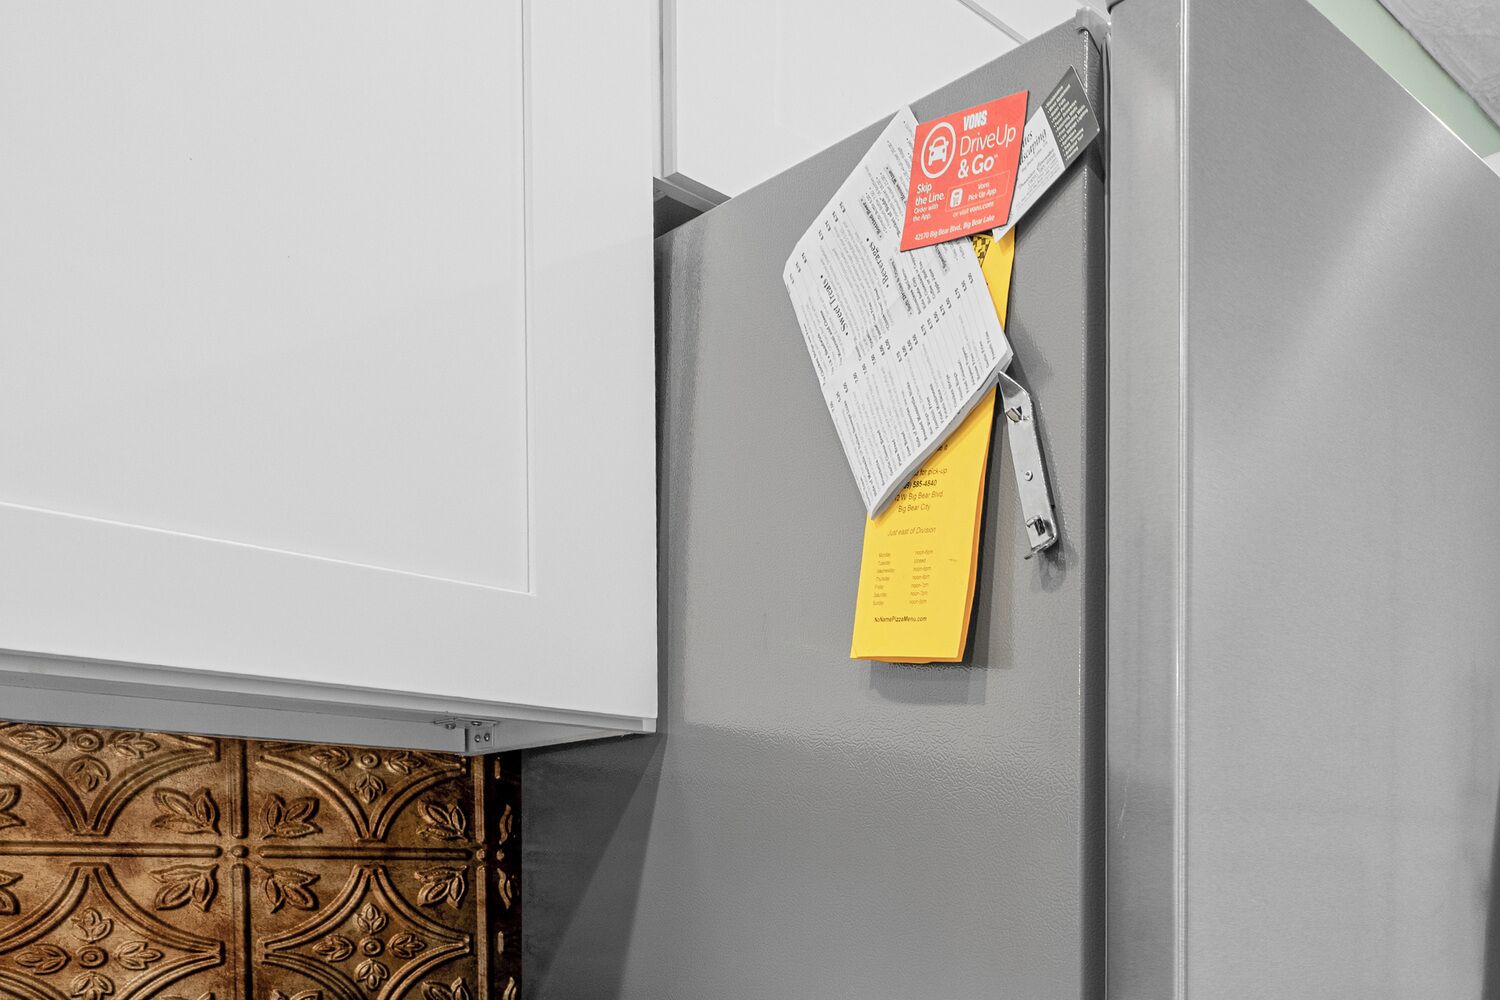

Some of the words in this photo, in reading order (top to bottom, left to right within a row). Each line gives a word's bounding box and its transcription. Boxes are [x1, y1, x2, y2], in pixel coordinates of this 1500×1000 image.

[963, 110, 988, 131] VONS
[960, 124, 1017, 156] DriveUp
[958, 159, 969, 179] &
[915, 195, 927, 206] the
[917, 183, 932, 194] Skip
[869, 242, 888, 285] Beverages
[823, 279, 835, 306] Treats
[833, 304, 846, 331] Sweet
